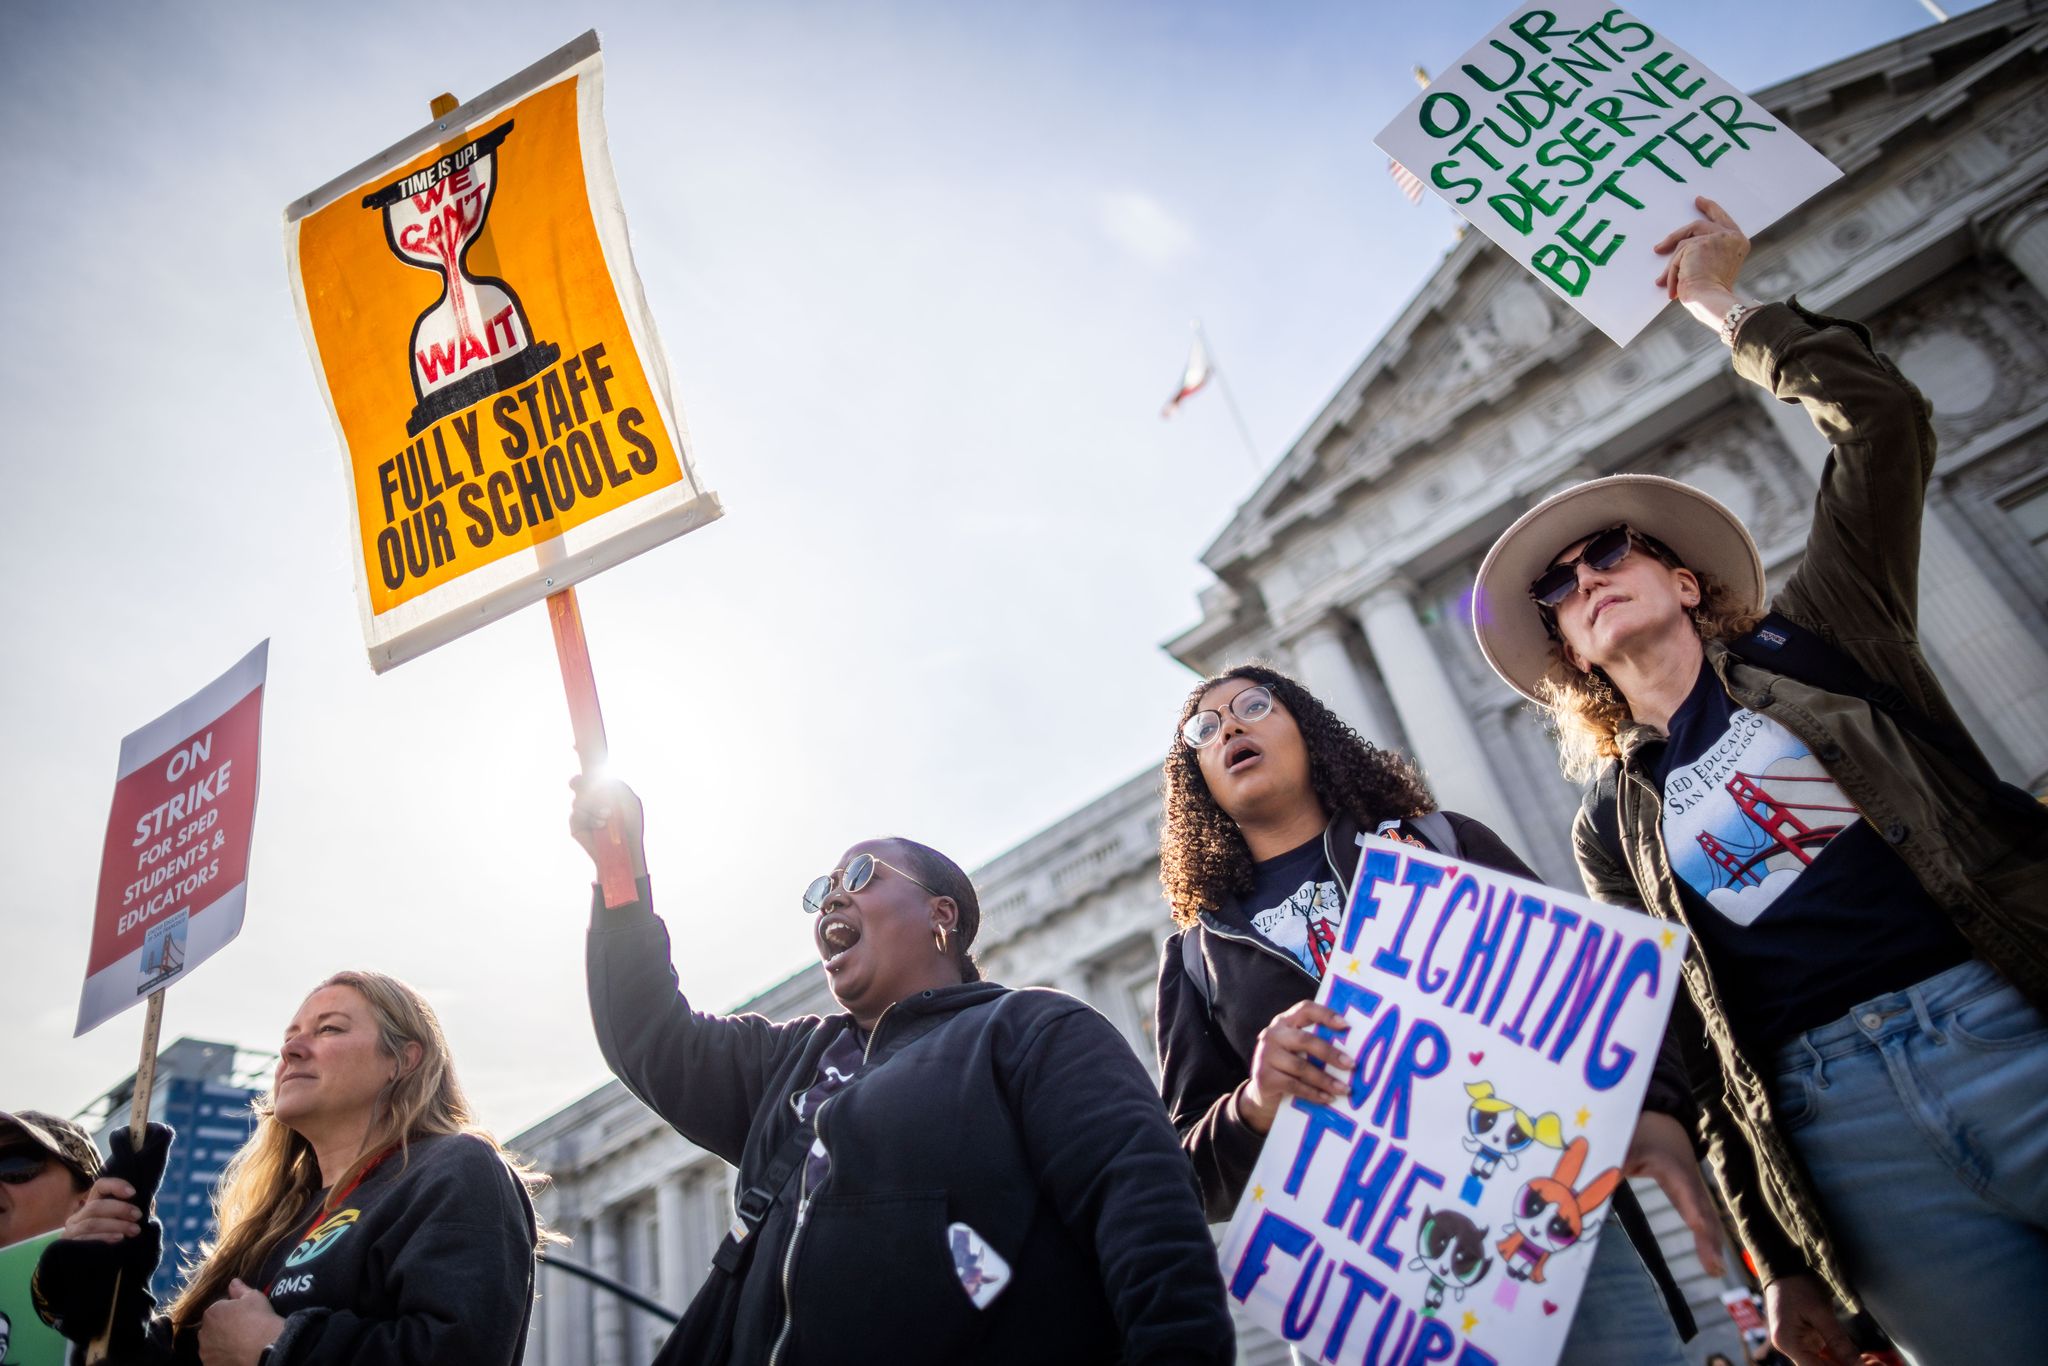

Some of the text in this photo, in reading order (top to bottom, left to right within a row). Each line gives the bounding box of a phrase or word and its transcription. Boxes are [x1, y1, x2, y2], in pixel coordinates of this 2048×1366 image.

[1418, 10, 1581, 139] OUR
[1430, 9, 1655, 205] STUDENTS
[398, 143, 478, 199] TIME IS UP!
[1488, 51, 1707, 236] DESERVE
[400, 182, 486, 252] CAN'T
[411, 167, 472, 214] WE
[1531, 94, 1777, 298] BETTER
[416, 304, 517, 384] WAIT
[378, 342, 615, 523] FULLY STAFF
[377, 406, 658, 590] OUR SCHOOLS
[166, 732, 213, 782] ON
[1668, 719, 1763, 815] SAN FRANCISCO
[132, 760, 232, 847] STRIKE
[138, 809, 218, 871] FOR SPED
[117, 858, 219, 937] EDUCATORS
[123, 828, 225, 906] STUDENTS &
[1283, 1097, 1445, 1273] THE
